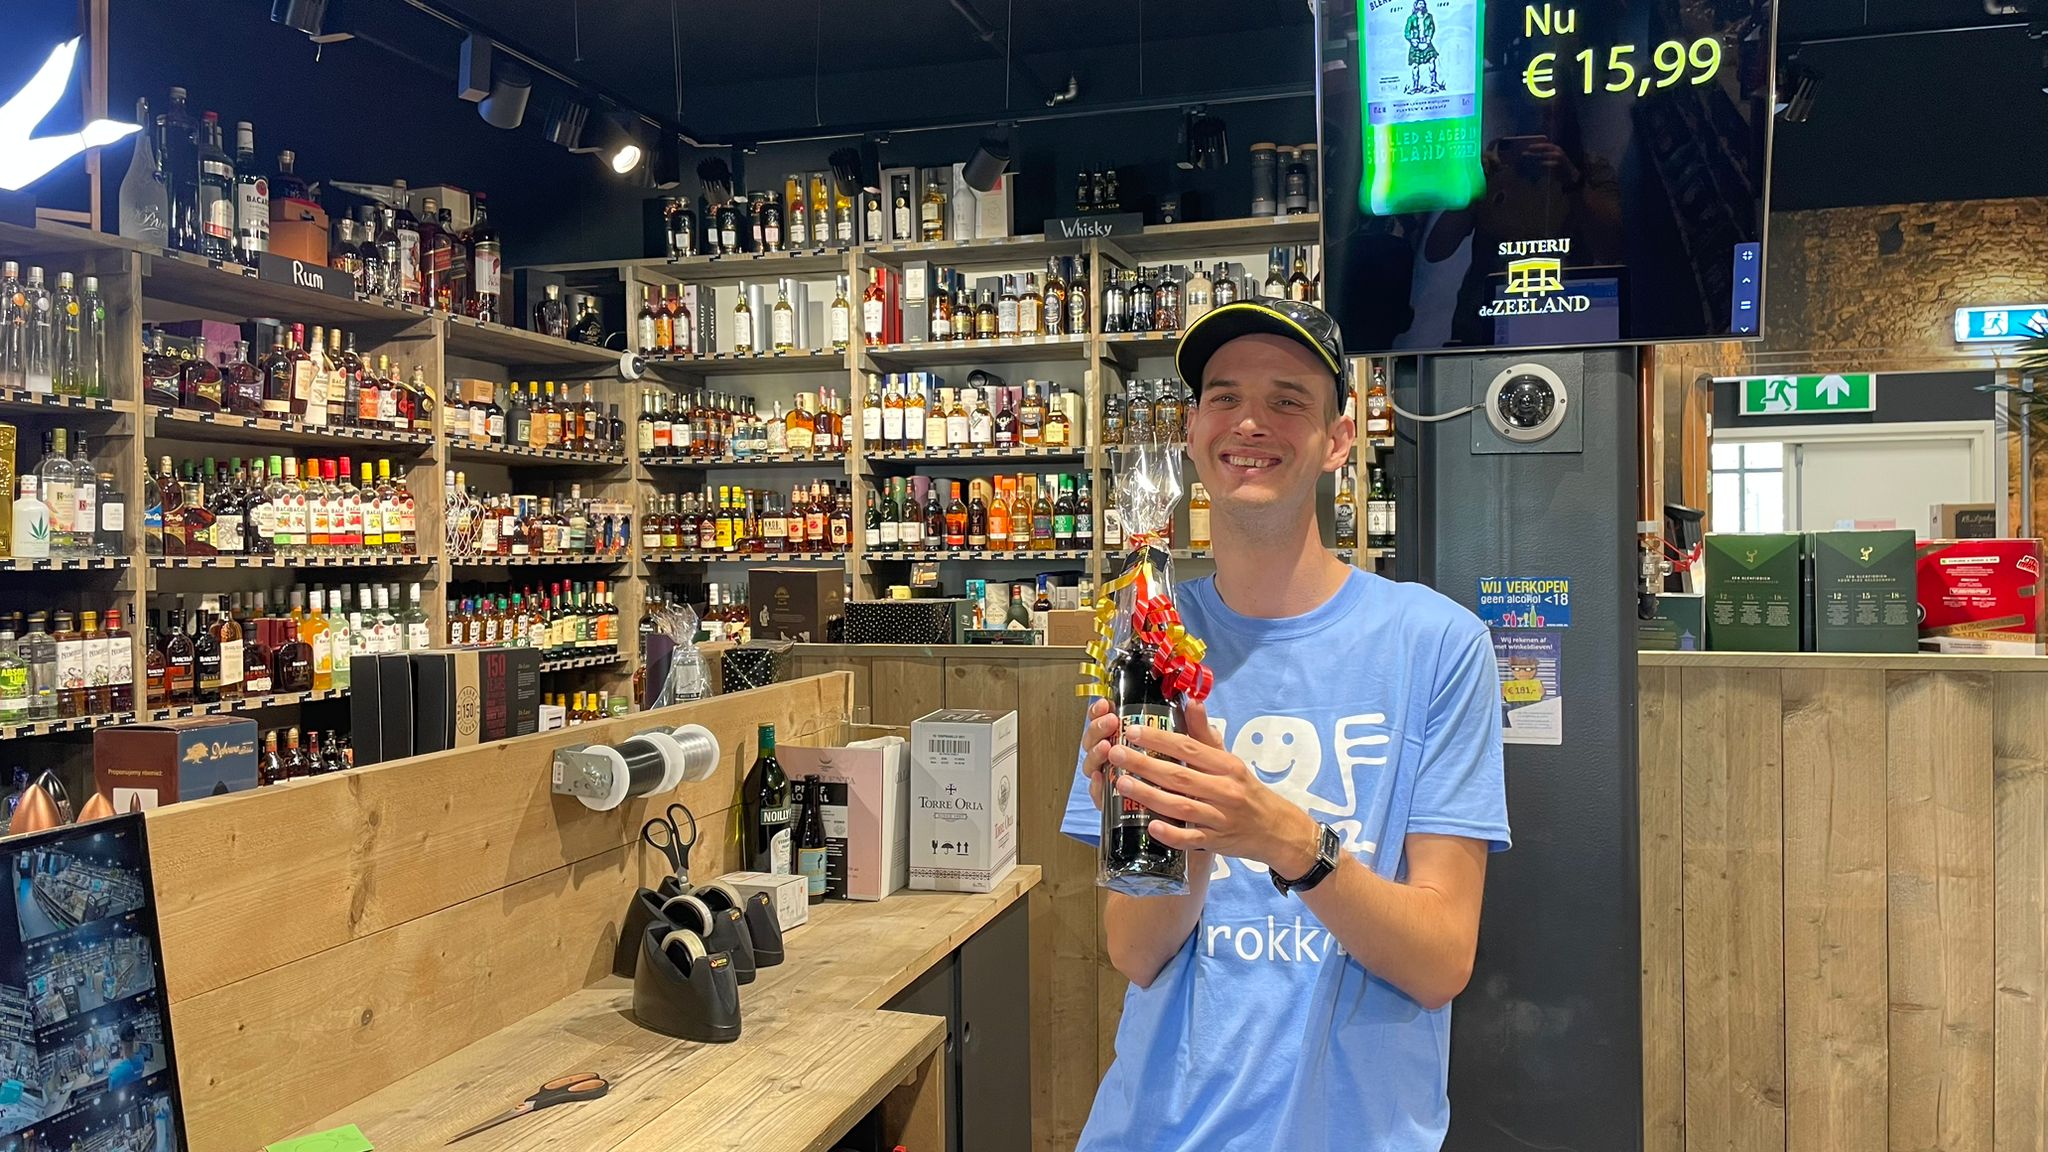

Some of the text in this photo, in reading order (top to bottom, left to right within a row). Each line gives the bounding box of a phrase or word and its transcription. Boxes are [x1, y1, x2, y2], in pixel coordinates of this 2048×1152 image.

[1525, 3, 1575, 38] Nu
[1522, 37, 1721, 98] € 15,99
[1060, 218, 1113, 241] Whisky
[1498, 238, 1571, 256] SLIJTERIJ
[292, 260, 324, 290] Rum
[1479, 295, 1591, 317] deZEELAND
[1481, 580, 1569, 594] WIJ VERKOPEN
[1481, 592, 1569, 606] geen alcohol <18
[1833, 592, 1842, 600] 12
[1862, 592, 1871, 600] 15
[1891, 592, 1900, 600] 18
[462, 703, 474, 718] 150
[763, 810, 790, 822] NOILLY
